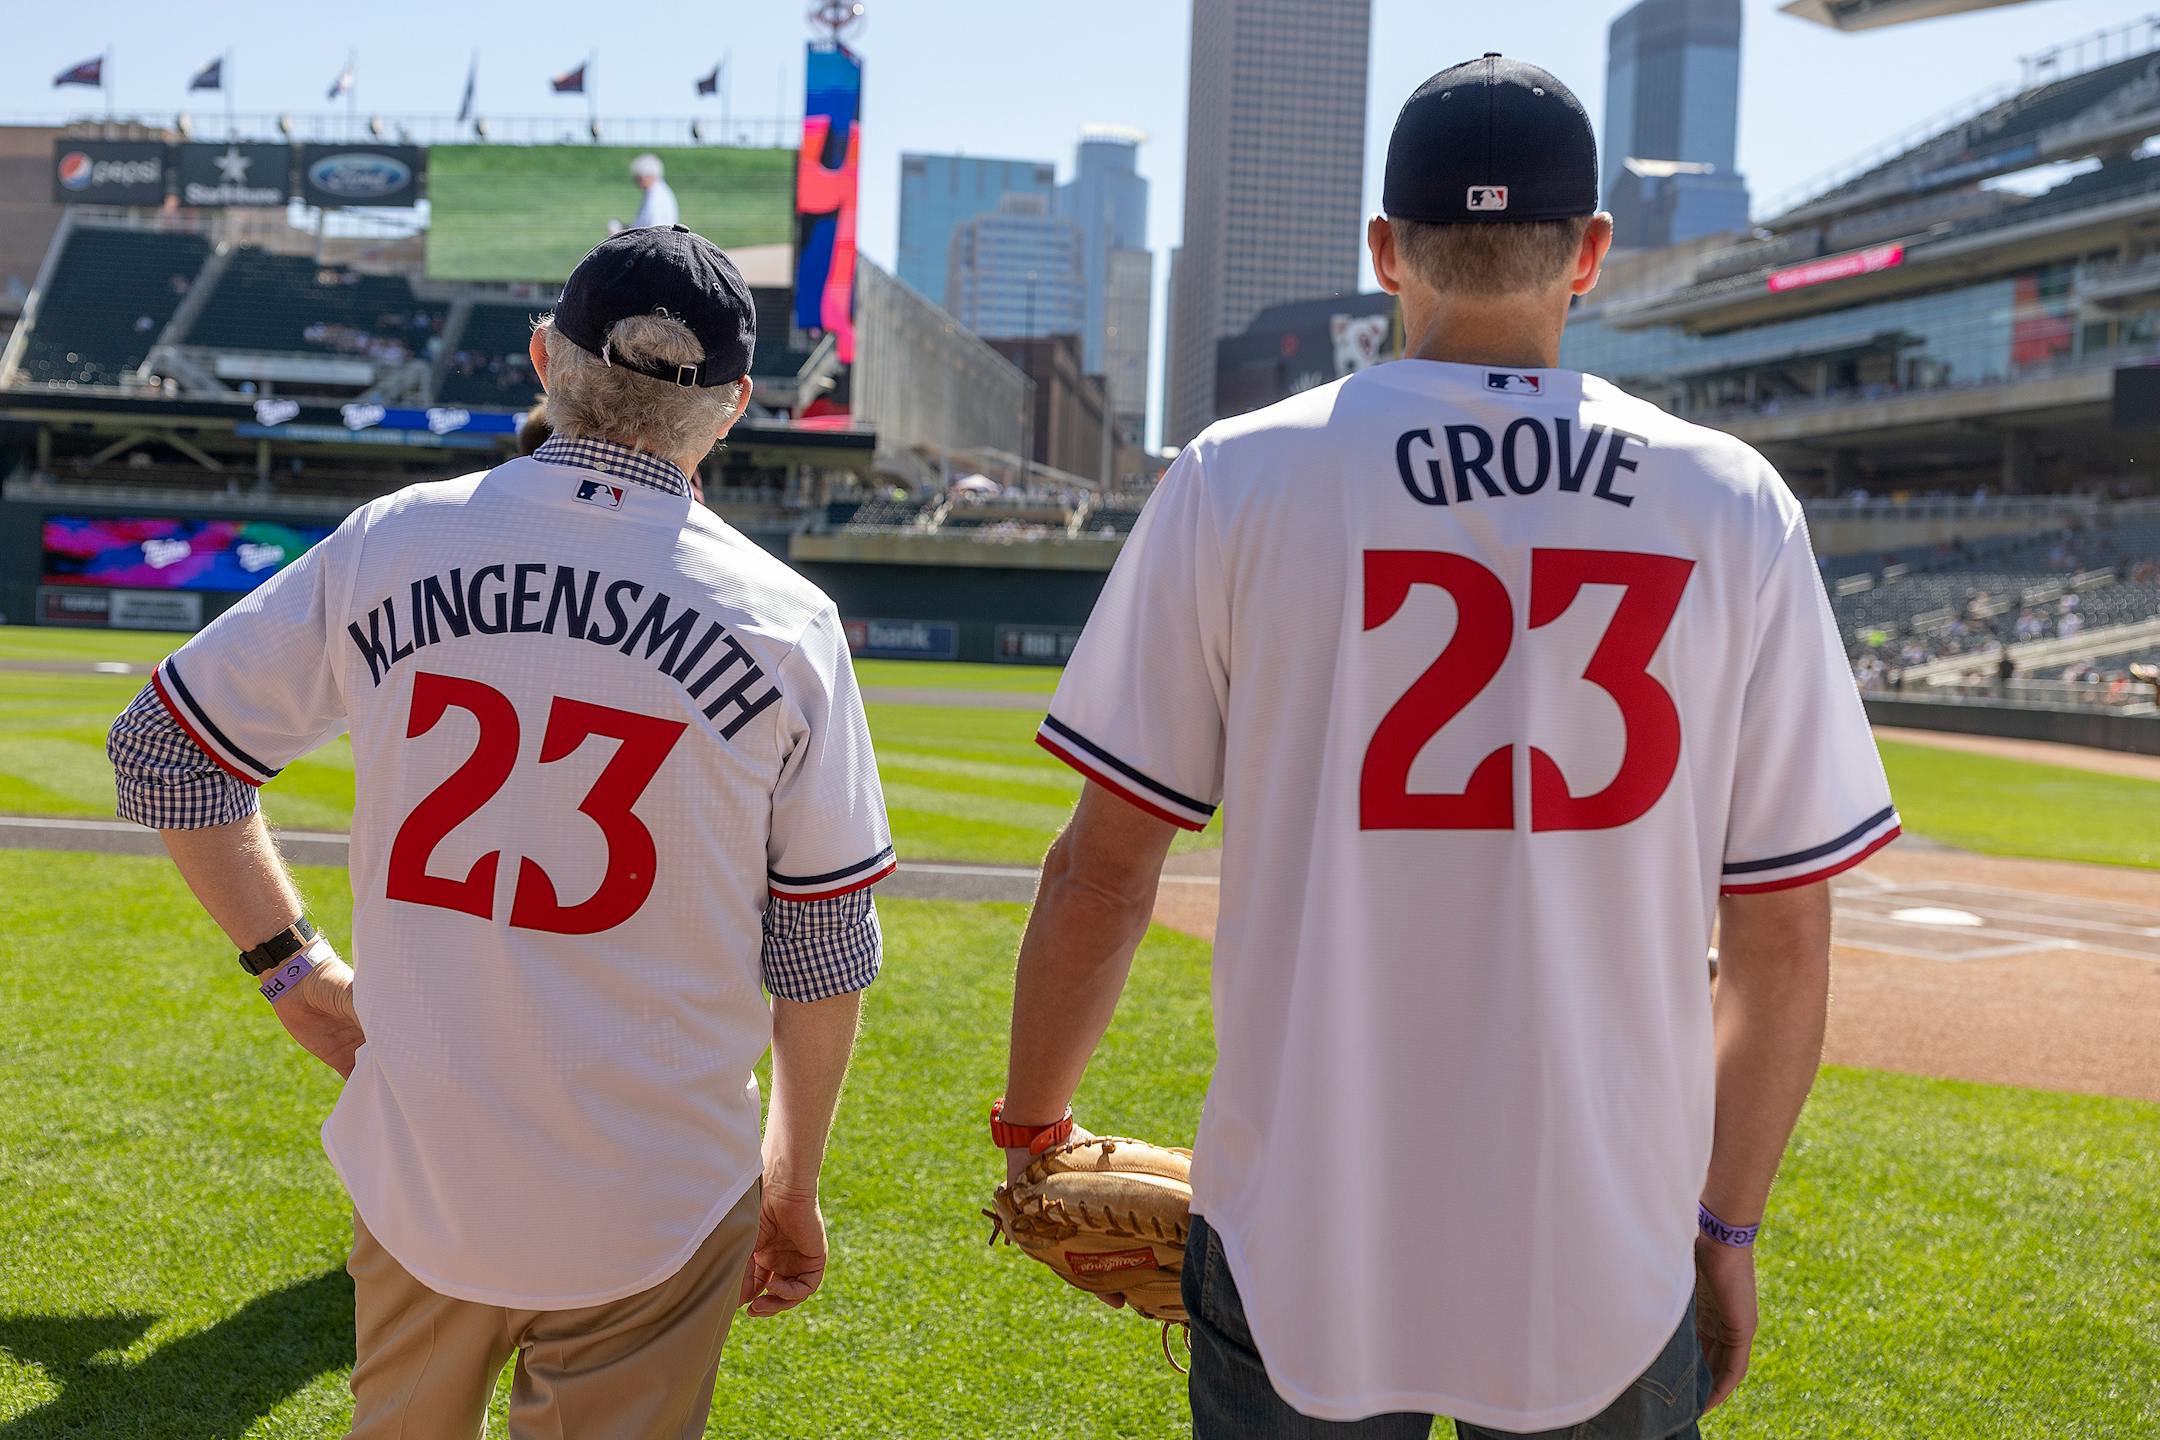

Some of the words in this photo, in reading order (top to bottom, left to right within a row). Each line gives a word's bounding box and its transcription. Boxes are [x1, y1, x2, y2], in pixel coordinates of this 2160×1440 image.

[1396, 417, 1648, 507] GROVE
[347, 563, 783, 742] KLINGENSMITH
[868, 622, 930, 649] bank
[1360, 548, 1697, 833] 23
[386, 671, 689, 935] 23
[1080, 1255, 1148, 1273] Rawlings
